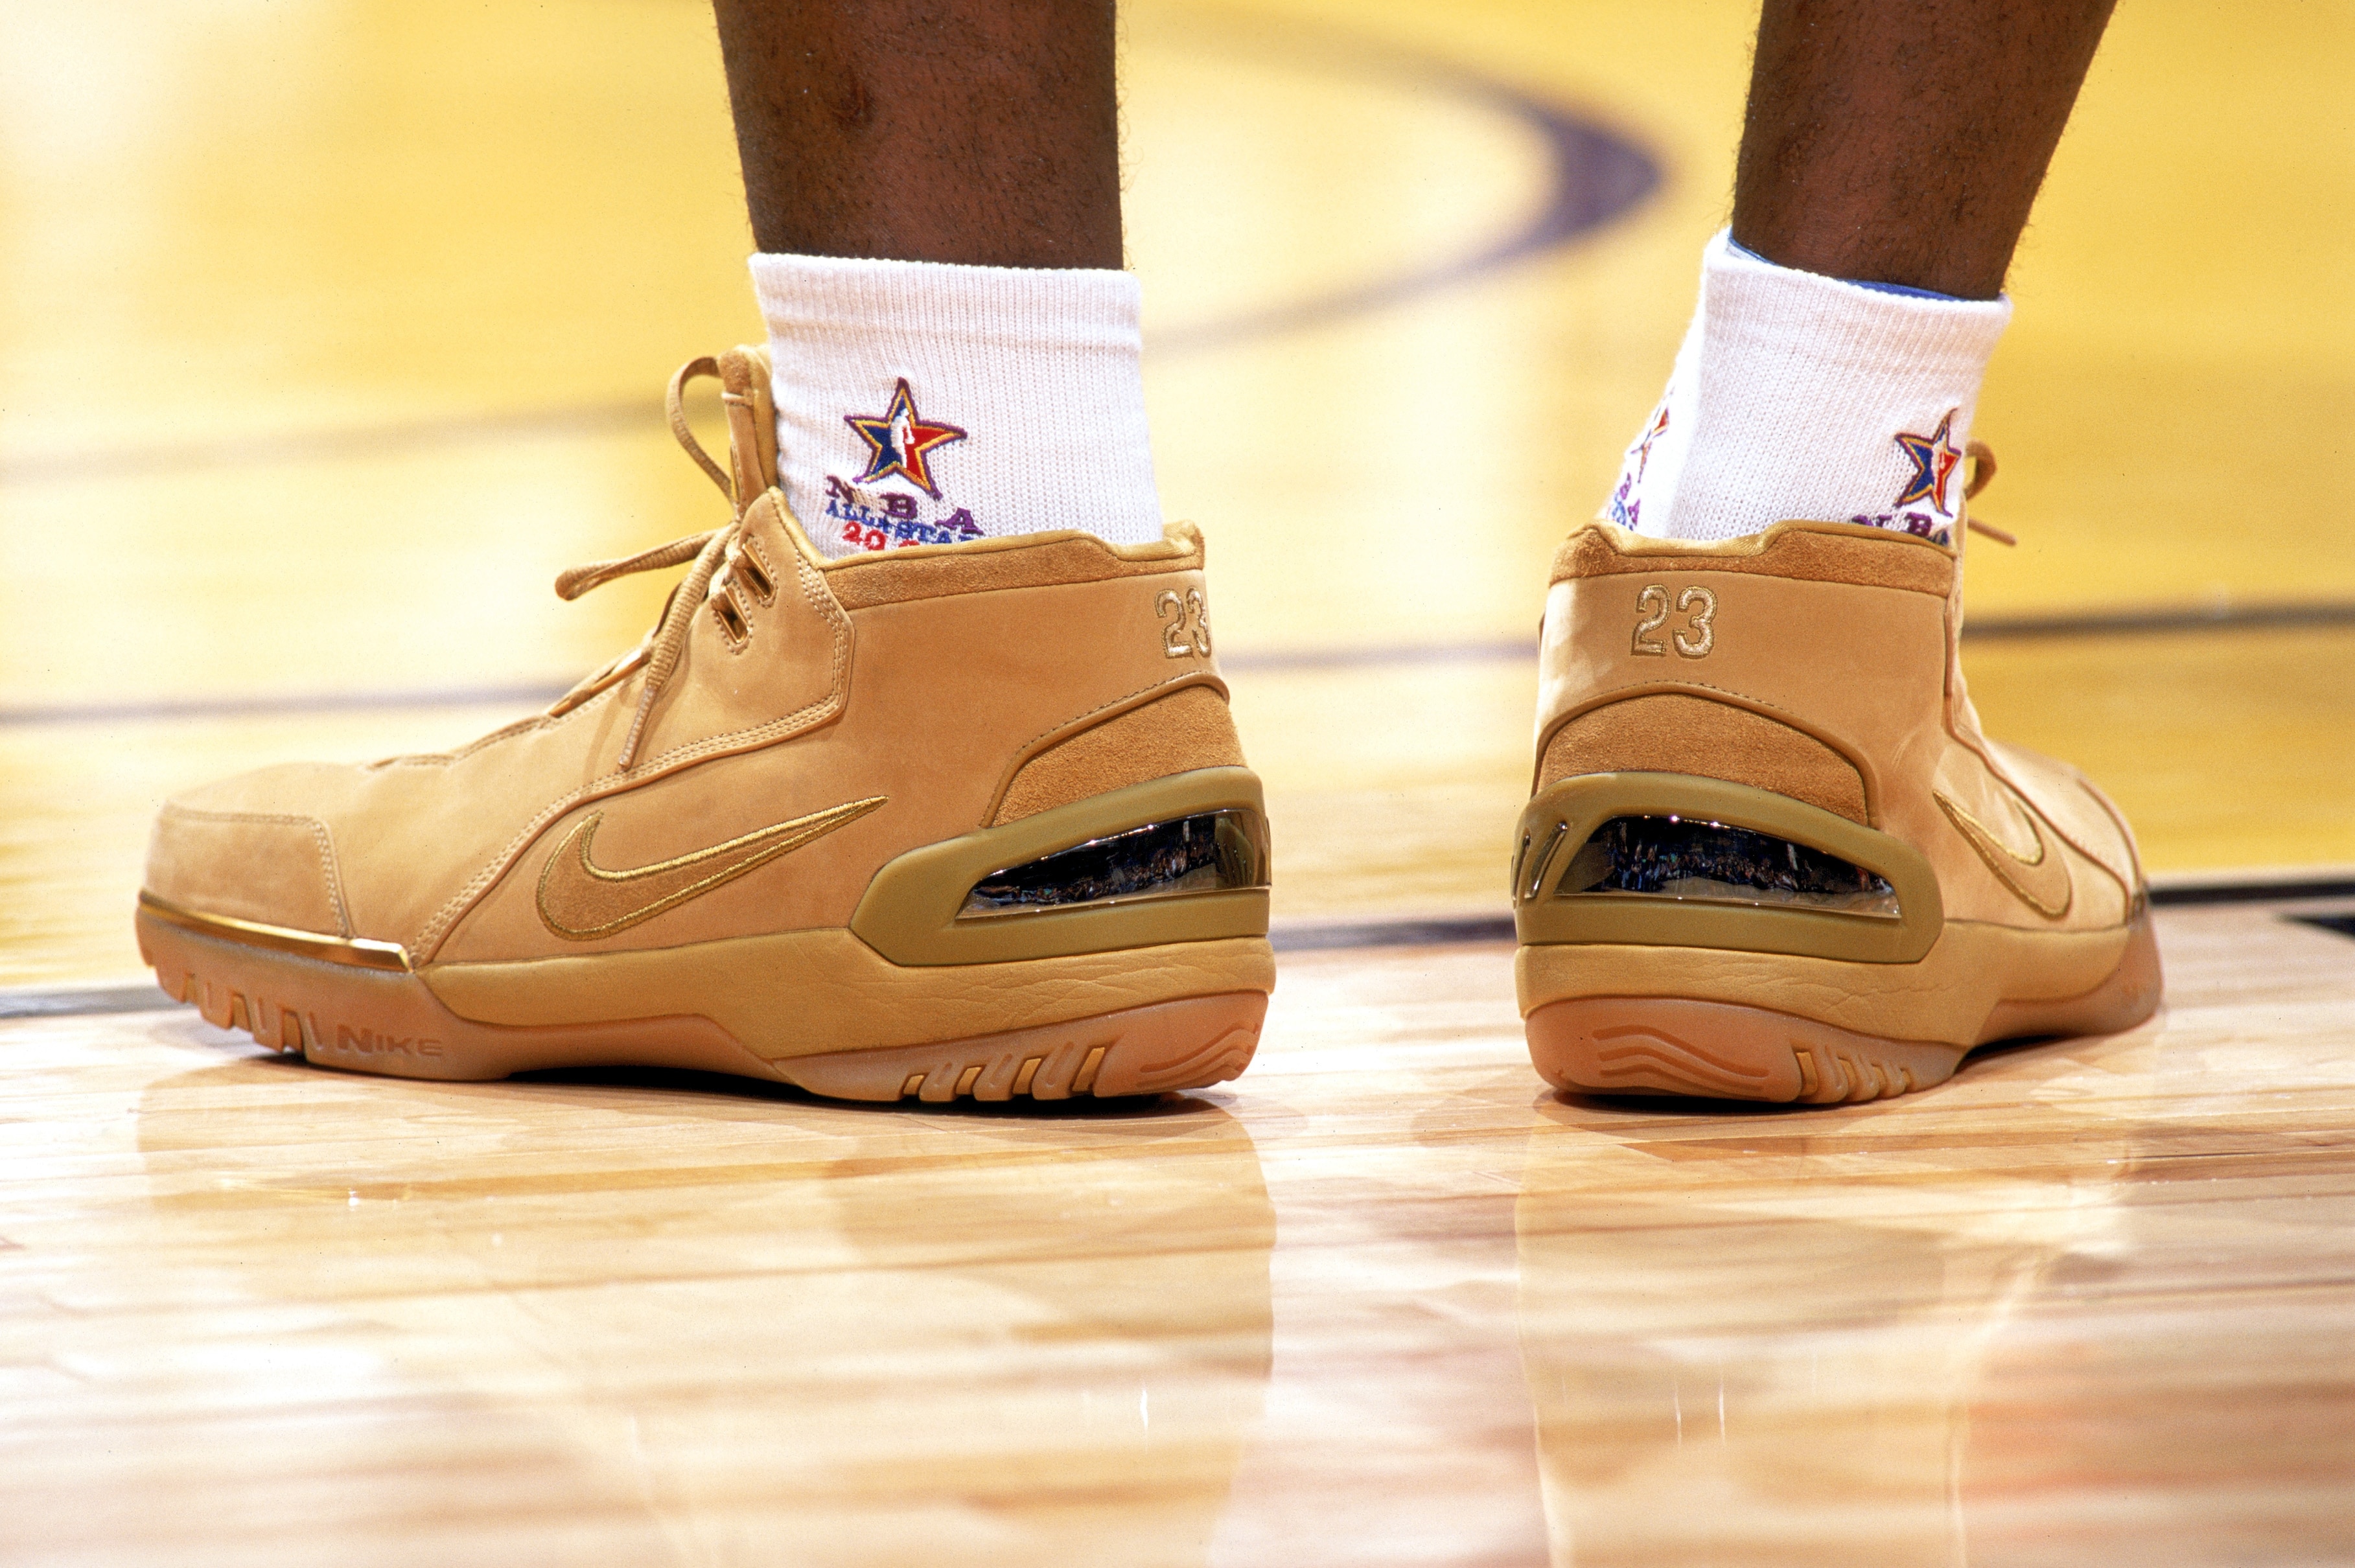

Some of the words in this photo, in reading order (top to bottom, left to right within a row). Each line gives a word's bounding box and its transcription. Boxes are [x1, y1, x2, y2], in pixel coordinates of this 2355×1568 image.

[842, 520, 920, 550] 20
[1155, 586, 1211, 659] 23
[1630, 584, 1717, 659] 23
[336, 1023, 443, 1057] NIKE
